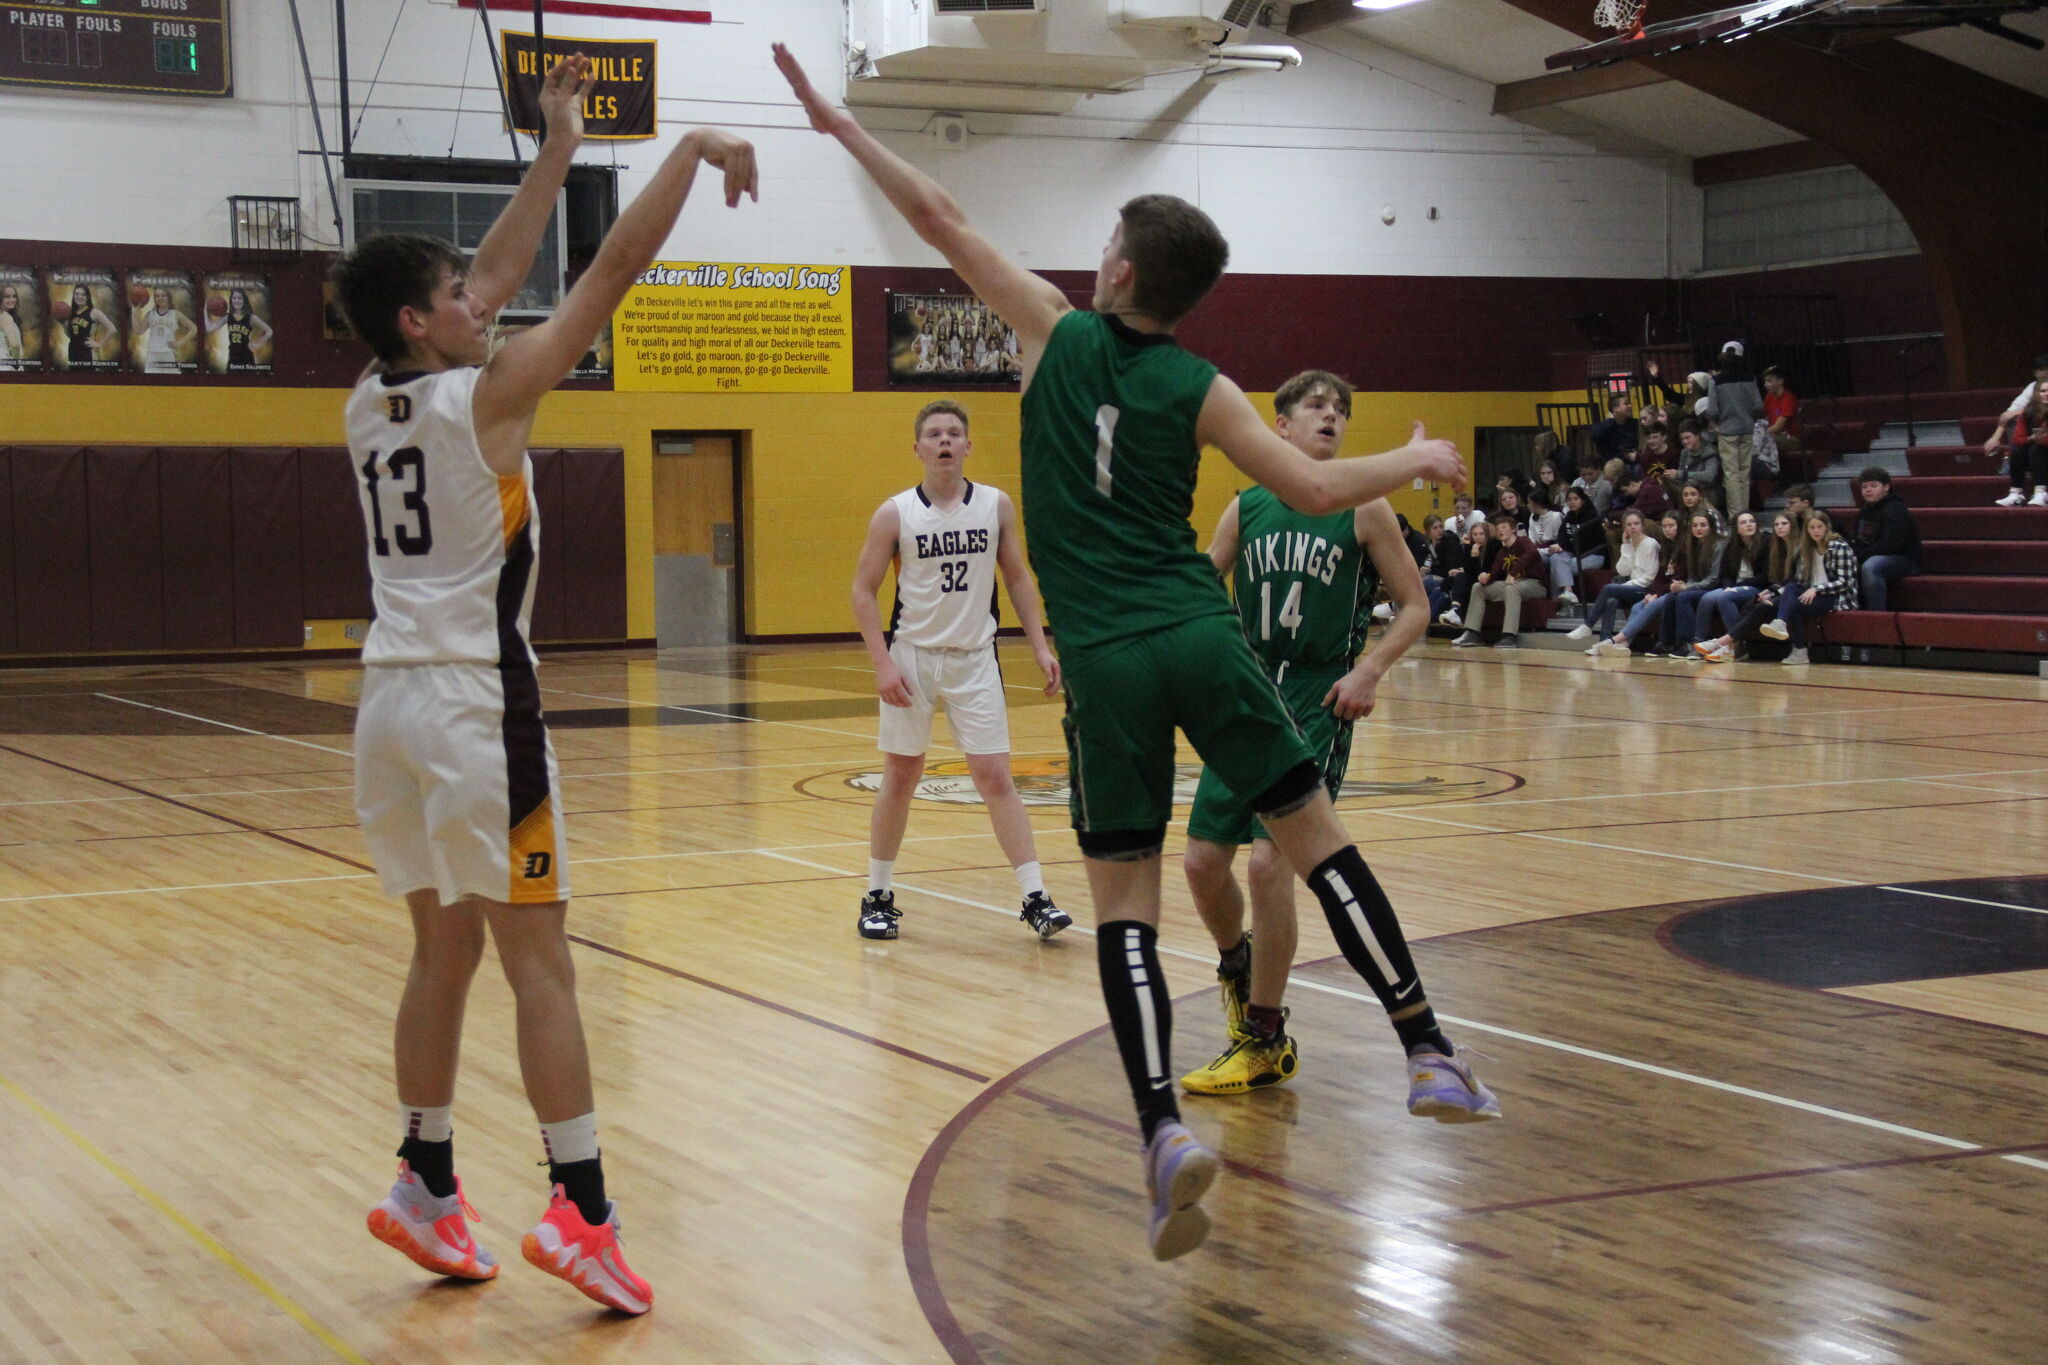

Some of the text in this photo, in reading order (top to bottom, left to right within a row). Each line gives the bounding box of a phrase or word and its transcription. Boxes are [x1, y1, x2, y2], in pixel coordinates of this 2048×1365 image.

[10, 11, 122, 32] PLAYER FOULS
[153, 22, 197, 38] FOULS
[518, 50, 643, 81] DECVILLE
[584, 95, 618, 119] LES
[634, 264, 844, 296] eckerville School Song
[635, 297, 645, 306] Oh
[646, 297, 686, 307] Deckerville
[688, 298, 703, 308] let's
[704, 299, 717, 308] win
[719, 299, 732, 309] this
[734, 301, 752, 311] game
[755, 300, 768, 309] and
[769, 300, 778, 309] all
[779, 301, 791, 310] the
[793, 302, 806, 310] rest
[624, 310, 645, 320] We're
[647, 310, 669, 321] proud
[671, 311, 680, 320] of
[696, 313, 725, 321] maroon
[727, 312, 741, 321] and
[743, 313, 759, 324] gold
[761, 313, 791, 322] because
[793, 313, 809, 324] they
[811, 313, 820, 323] all
[822, 314, 843, 323] excel.
[621, 323, 634, 332] For
[636, 324, 693, 335] sportsmanship
[695, 325, 709, 334] and
[711, 325, 760, 335] fearlessness,
[774, 326, 790, 335] hold
[791, 327, 798, 335] in
[800, 327, 816, 338] high
[817, 327, 847, 336] esteem.
[626, 336, 843, 349] For quality and high moral of all our Deckerville teams.
[637, 351, 657, 360] Let's
[659, 353, 671, 363] go
[695, 354, 707, 363] go
[745, 353, 782, 363] go-go-go
[784, 352, 832, 362] Deckerville.
[639, 364, 659, 373] Let's
[661, 366, 672, 376] go
[696, 366, 708, 376] go
[745, 366, 782, 376] go-go-go
[783, 365, 831, 375] Deckerville.
[716, 378, 742, 388] Fight.
[1095, 404, 1119, 498] 1
[362, 446, 433, 557] 13
[915, 529, 988, 559] EAGLES
[1244, 531, 1343, 586] VIKINGS
[941, 561, 968, 593] 32
[1260, 581, 1303, 640] 14
